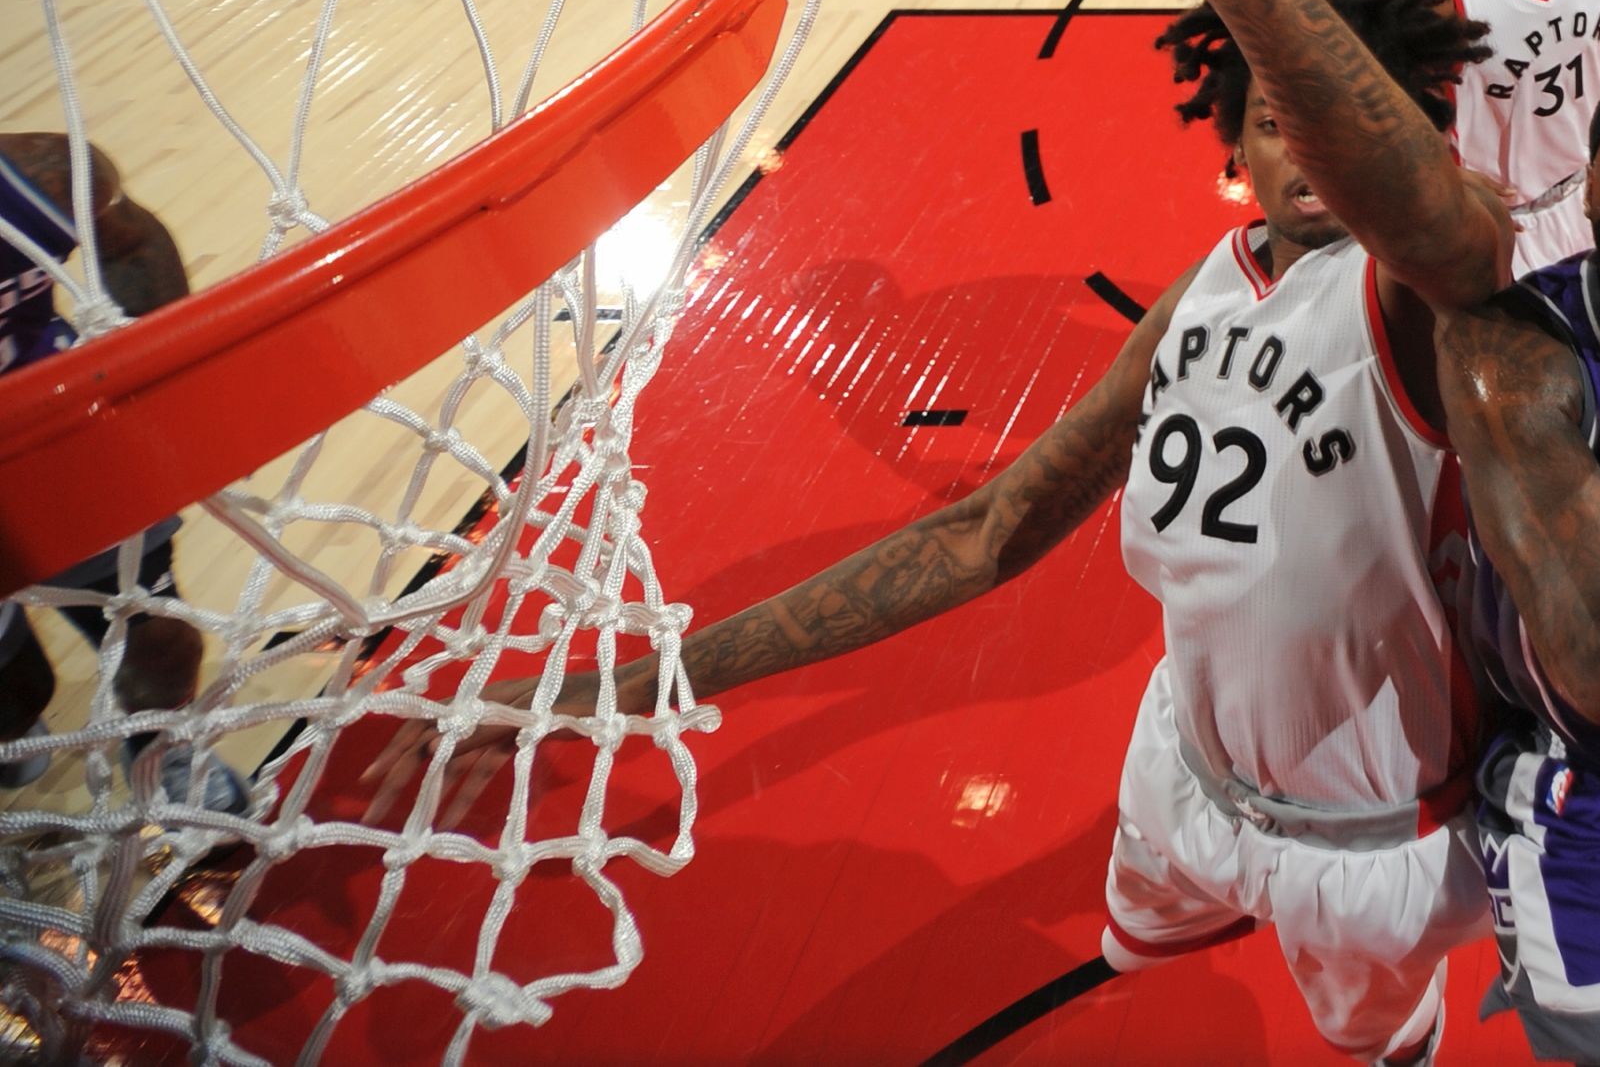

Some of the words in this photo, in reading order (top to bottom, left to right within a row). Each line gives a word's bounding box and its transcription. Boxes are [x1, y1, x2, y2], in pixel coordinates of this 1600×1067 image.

[1532, 52, 1585, 118] 31
[1137, 324, 1357, 478] APTORS
[1148, 412, 1268, 545] 92
